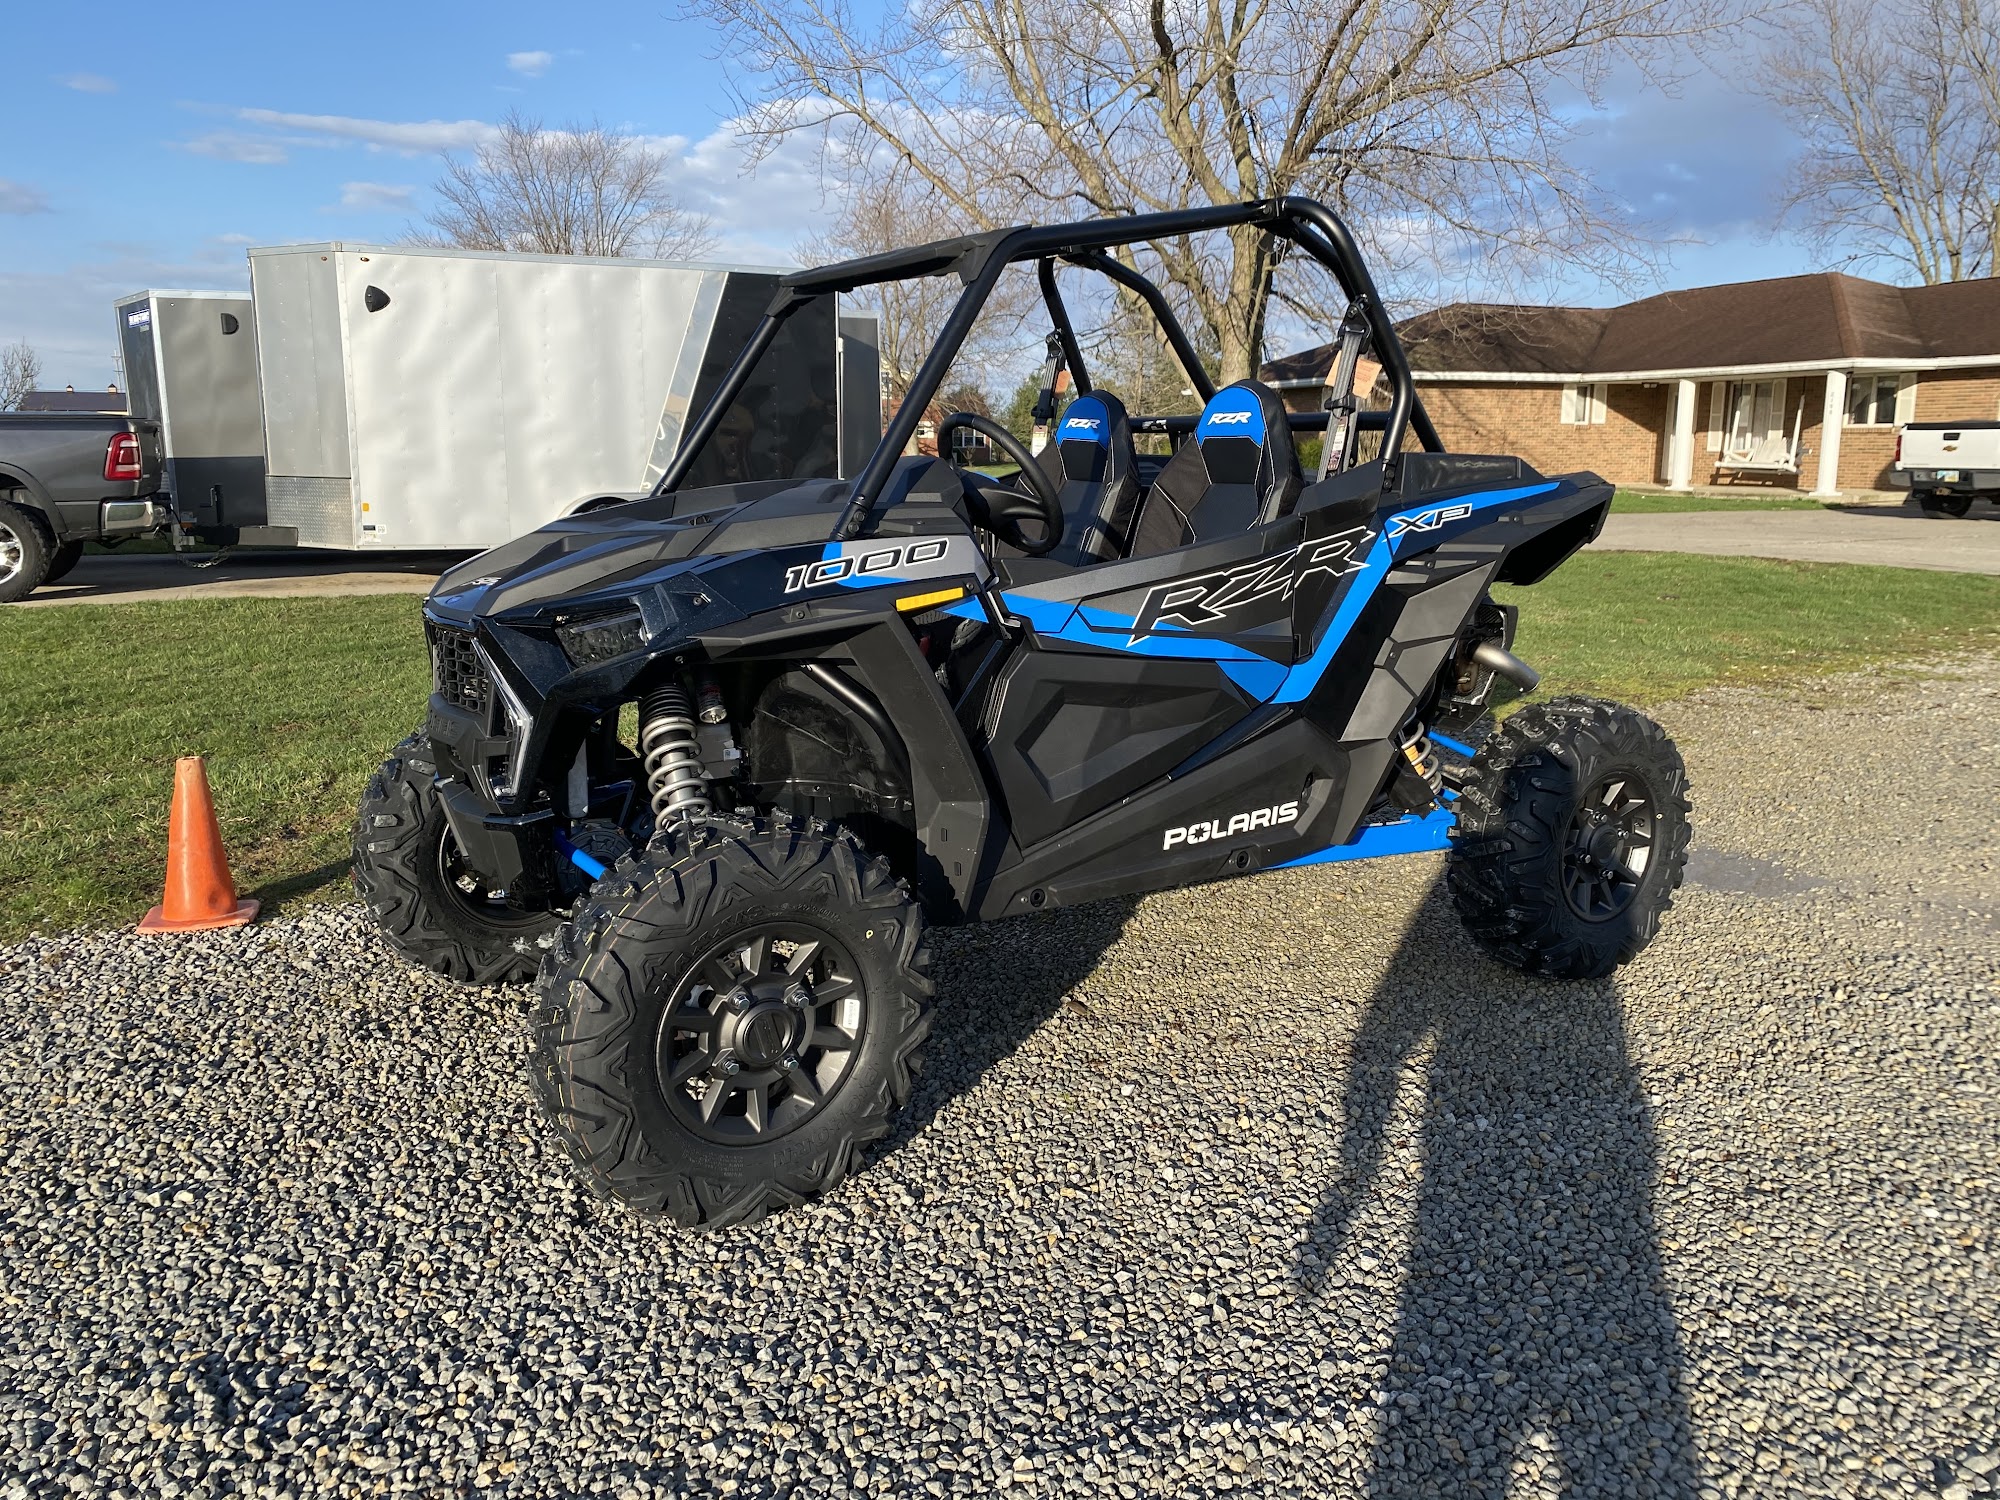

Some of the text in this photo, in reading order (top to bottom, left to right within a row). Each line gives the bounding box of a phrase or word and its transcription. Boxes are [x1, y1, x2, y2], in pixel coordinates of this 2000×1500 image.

[1065, 417, 1100, 429] RZR
[1207, 411, 1252, 426] RZR
[1383, 503, 1472, 543] XP
[784, 537, 949, 593] 1000
[1126, 526, 1376, 648] RZR
[1163, 801, 1299, 850] POLARIS
